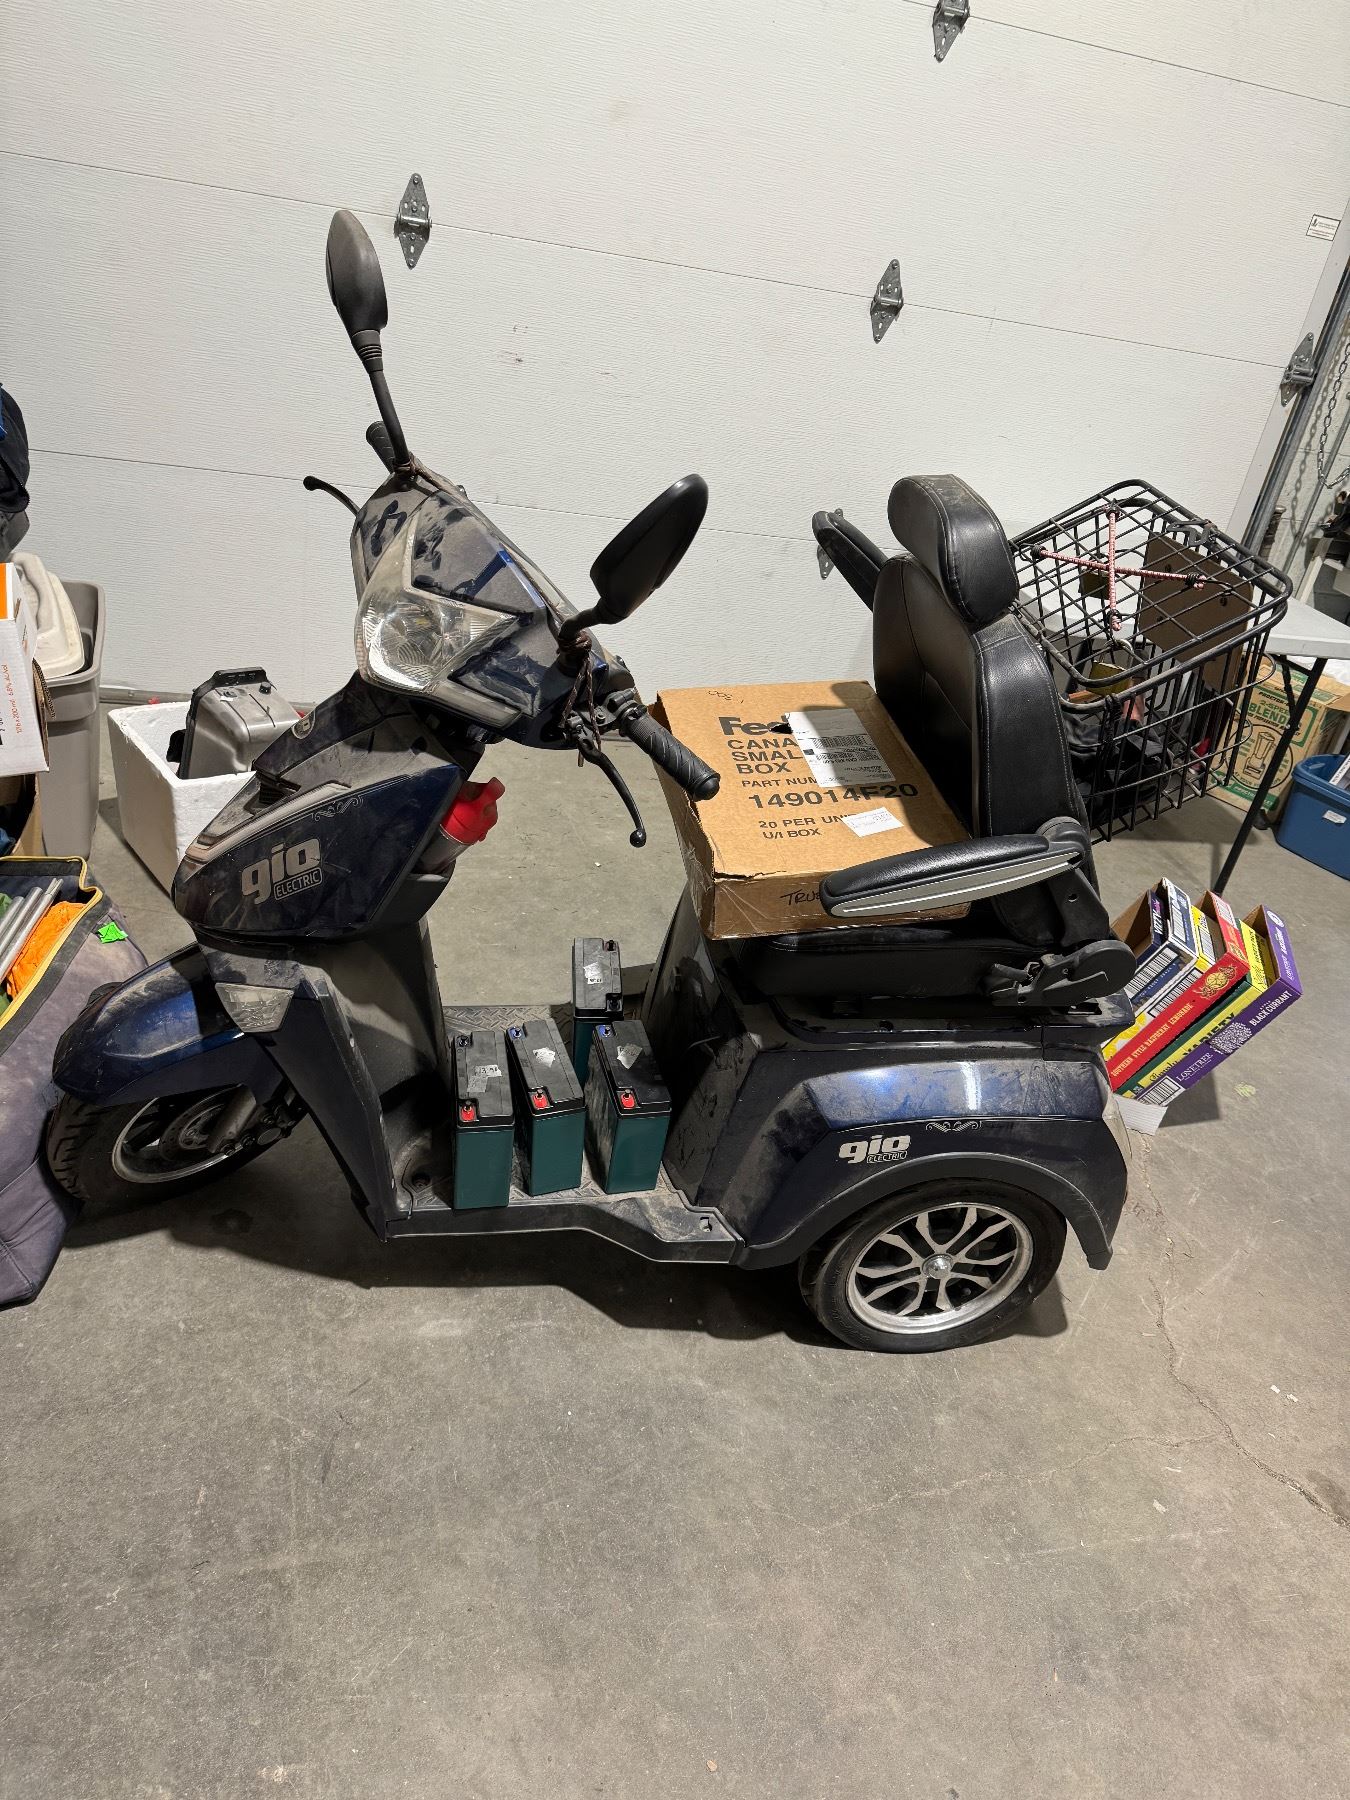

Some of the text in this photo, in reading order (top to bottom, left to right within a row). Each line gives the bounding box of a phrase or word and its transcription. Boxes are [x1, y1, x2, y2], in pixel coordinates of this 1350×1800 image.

[727, 737, 799, 750] CANA
[731, 749, 804, 762] SMAL
[735, 761, 793, 775] BOX
[741, 779, 781, 788] PART
[748, 783, 919, 808] 149014F20
[758, 820, 778, 829] 20
[783, 817, 816, 828] PER
[762, 828, 822, 840] U/I BOX
[241, 839, 320, 904] gio
[275, 870, 320, 897] ELECTRIC
[1249, 990, 1293, 1027] BLACK CURRANT
[1111, 1002, 1194, 1077] SOUTHERN STYLE RASPBERRY LEMONADE
[1176, 1052, 1214, 1082] LONETREE
[838, 1135, 910, 1163] gio
[867, 1151, 907, 1163] ELECTRIC
